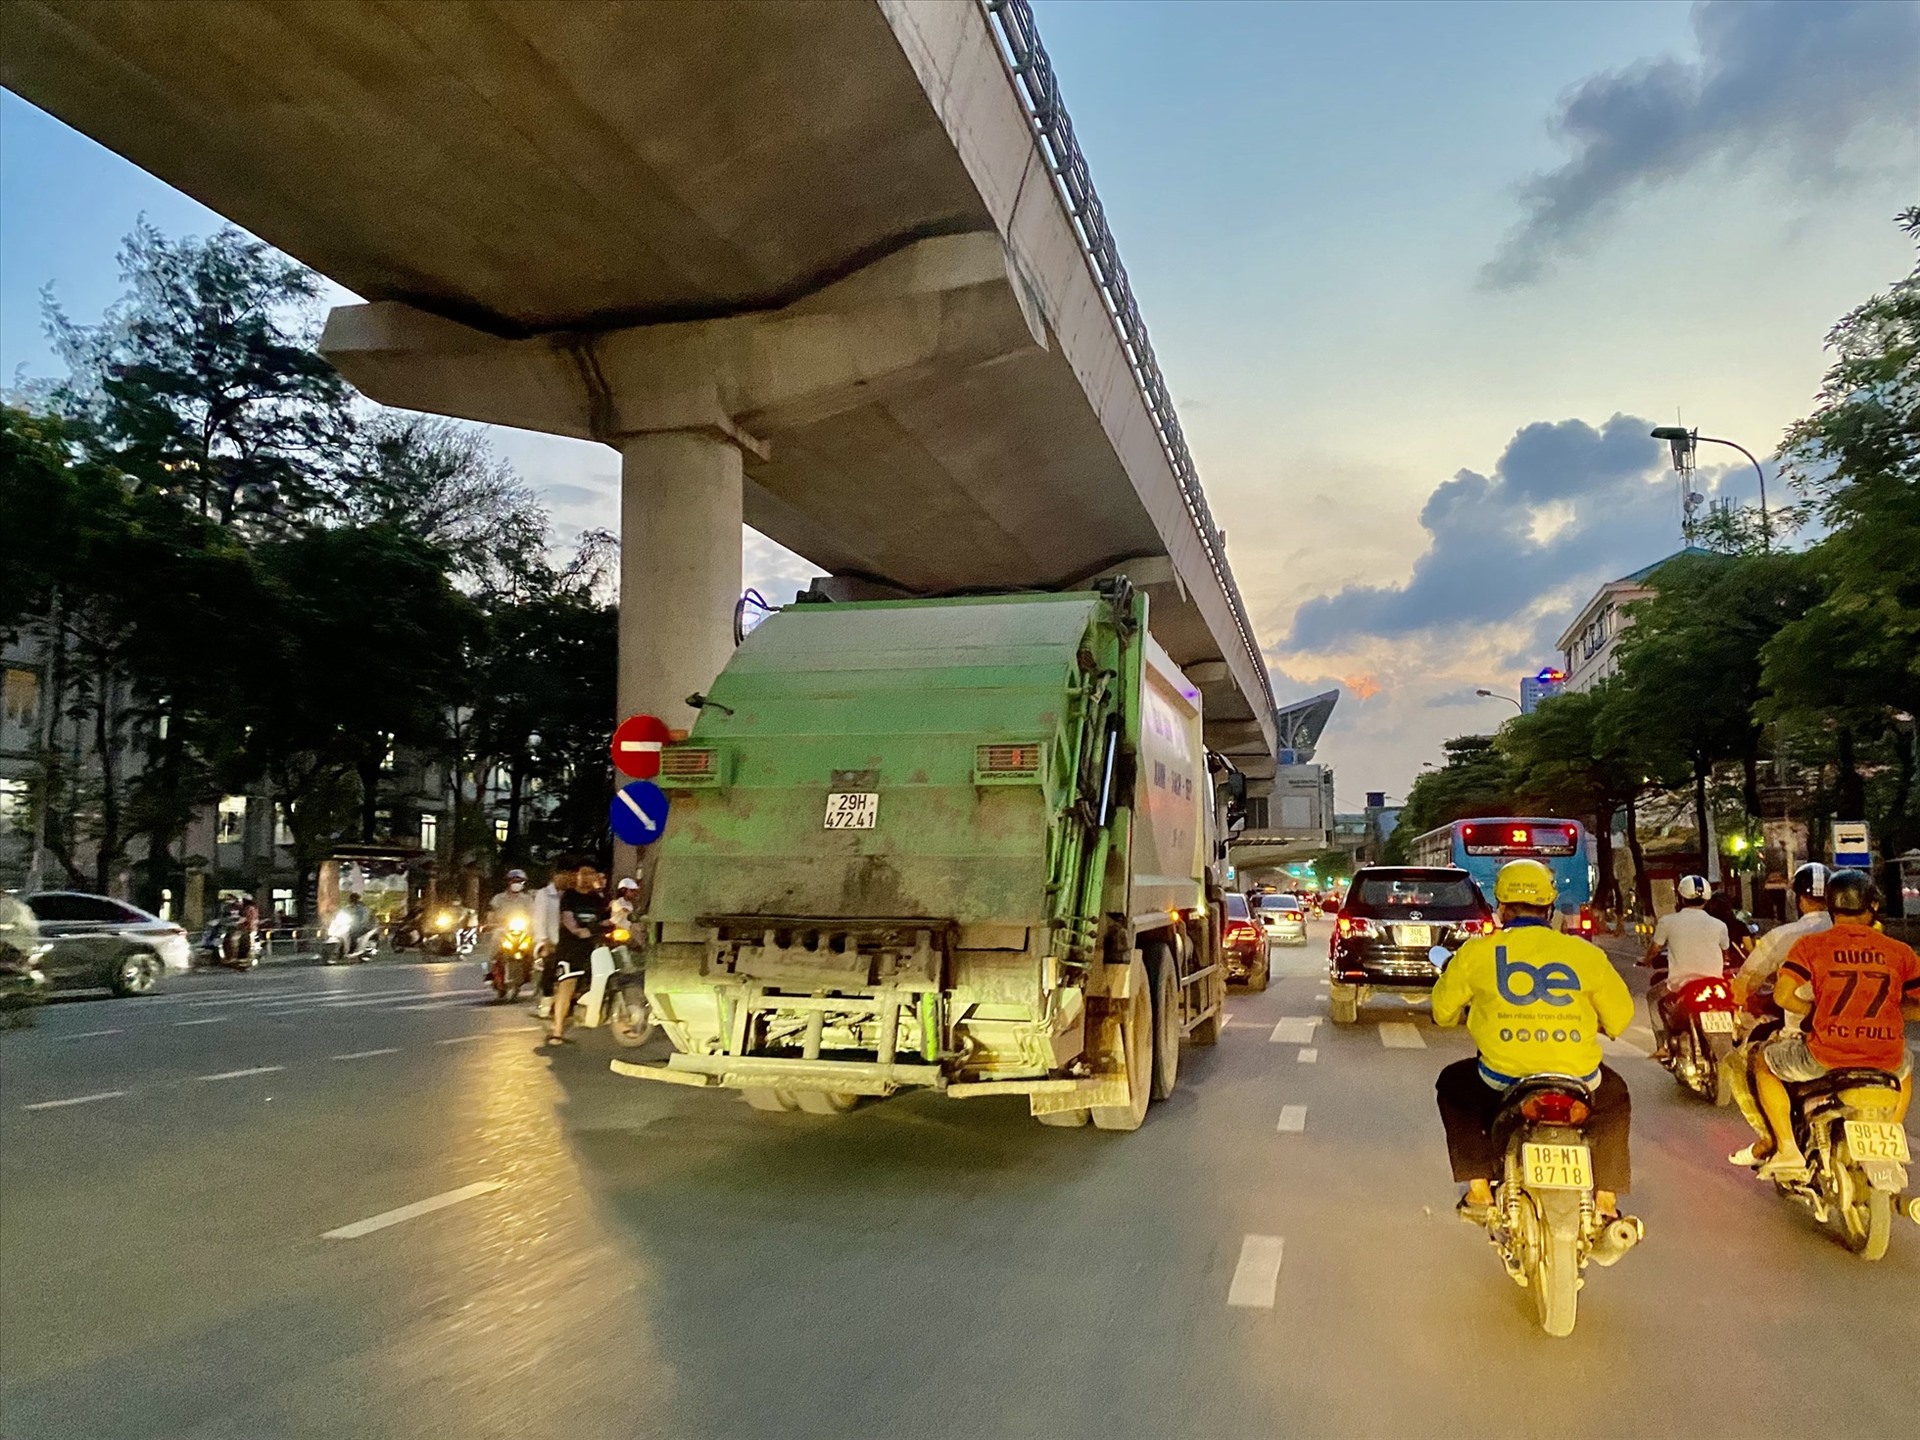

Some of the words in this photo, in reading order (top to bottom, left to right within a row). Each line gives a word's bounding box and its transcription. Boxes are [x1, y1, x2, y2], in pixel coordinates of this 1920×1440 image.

[839, 795, 867, 810] 29H
[826, 811, 874, 827] 472.41
[1833, 946, 1886, 965] QUỐC
[1495, 945, 1581, 1006] be
[1827, 970, 1891, 1019] 77
[1827, 1024, 1849, 1038] FC
[1855, 1026, 1896, 1040] FULL
[1854, 1124, 1896, 1140] 98-L4
[1534, 1147, 1579, 1165] 18-N1
[1857, 1140, 1900, 1157] 9422
[1534, 1166, 1582, 1185] 8718
